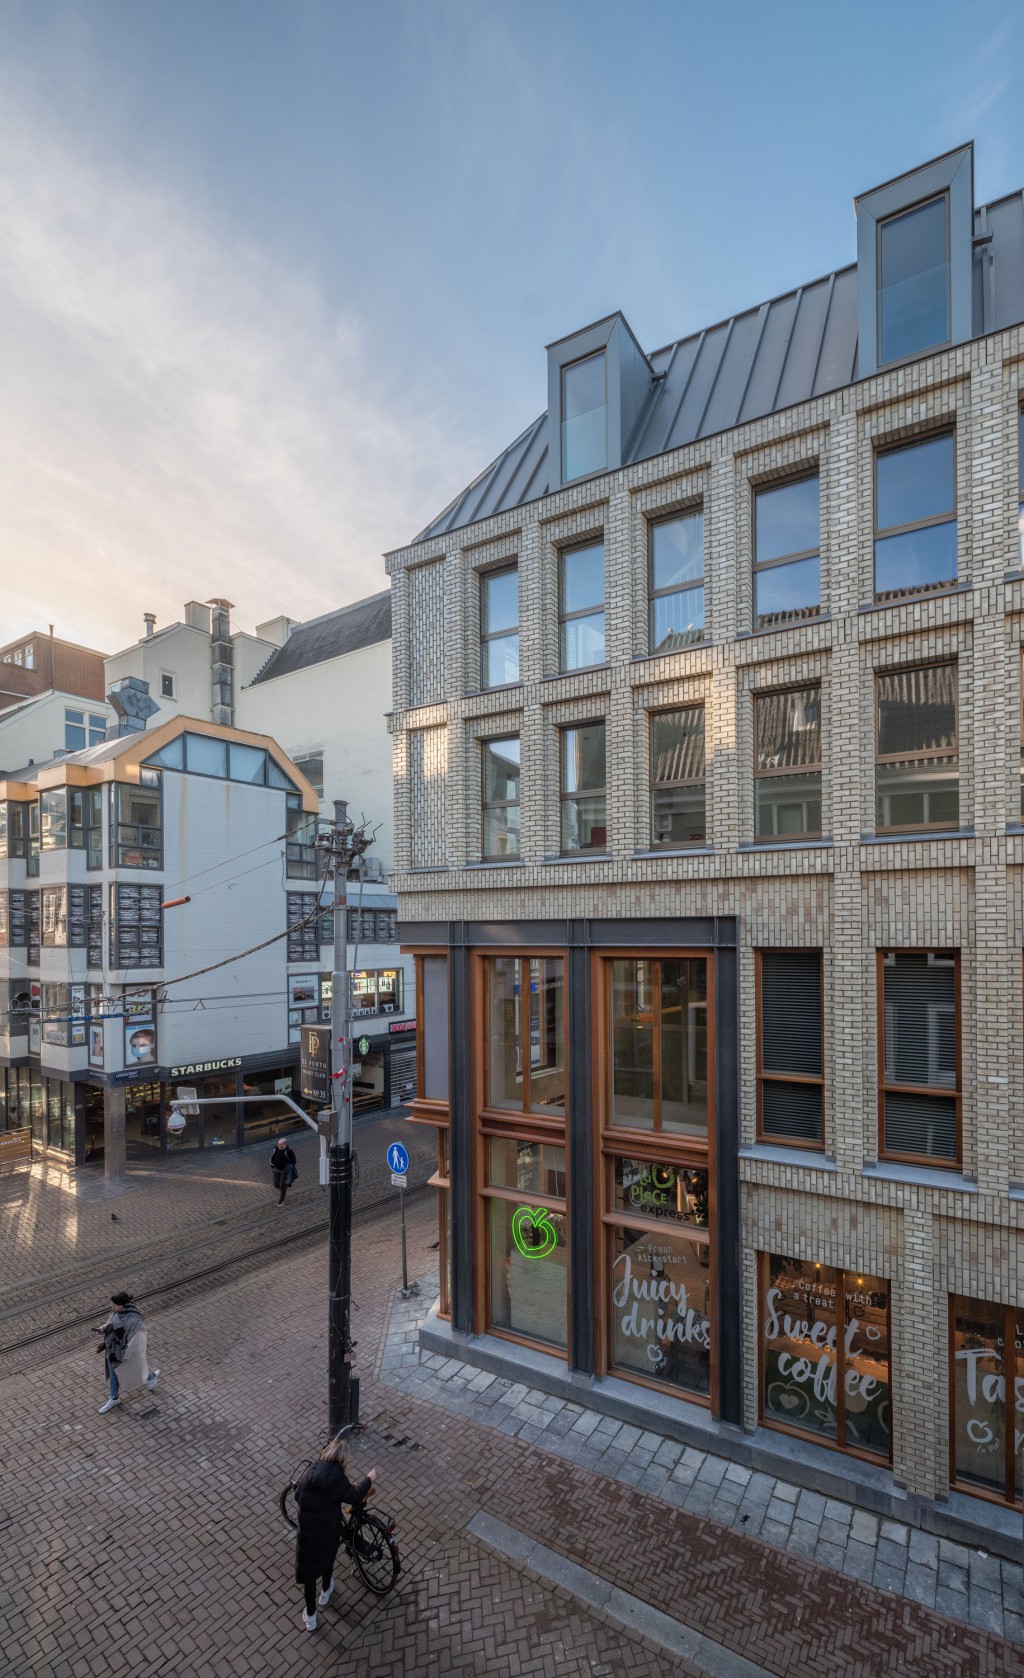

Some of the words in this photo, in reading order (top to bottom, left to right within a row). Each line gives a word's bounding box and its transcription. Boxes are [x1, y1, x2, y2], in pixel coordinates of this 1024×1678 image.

[171, 1057, 242, 1077] STARBUCKS
[640, 1204, 690, 1221] express
[648, 1244, 674, 1254] Fresh
[637, 1253, 688, 1264] kick-start
[612, 1253, 691, 1317] Juicy
[798, 1280, 837, 1297] Coffee
[845, 1291, 872, 1306] with
[803, 1293, 834, 1309] treat
[621, 1301, 711, 1350] drinks
